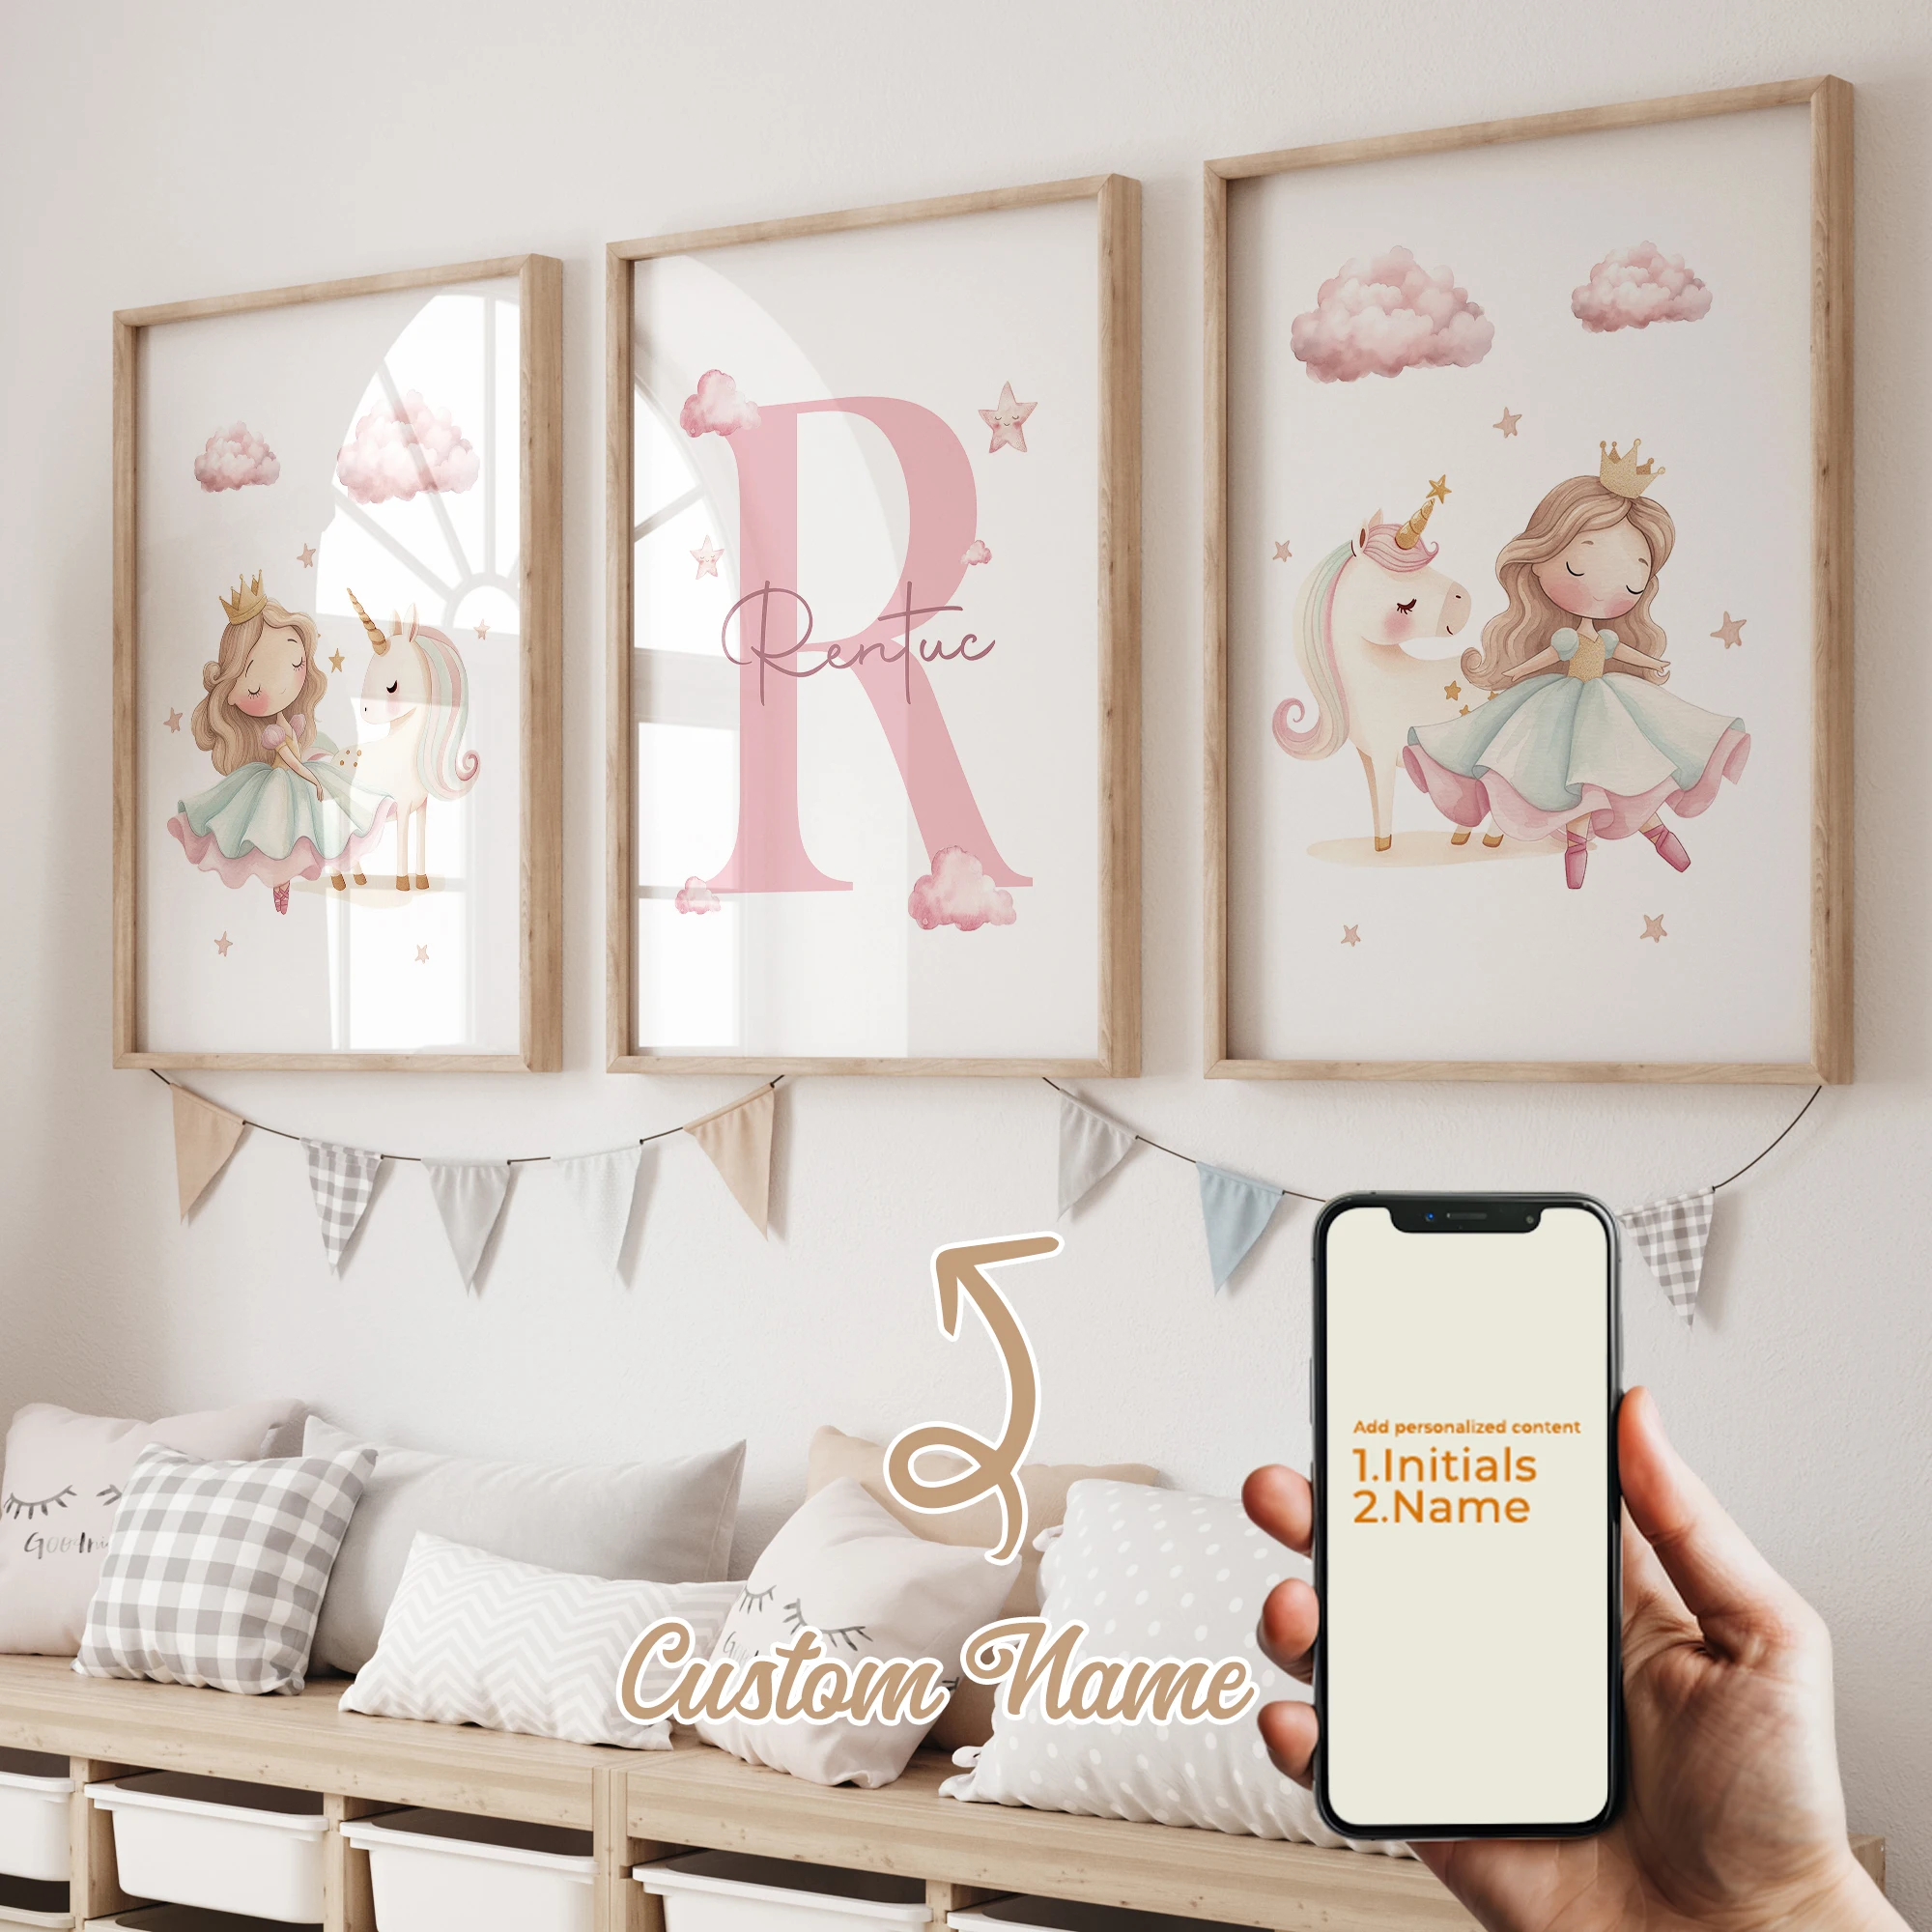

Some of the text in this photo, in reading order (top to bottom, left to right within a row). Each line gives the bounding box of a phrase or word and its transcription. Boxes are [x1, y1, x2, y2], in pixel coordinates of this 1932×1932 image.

[703, 396, 1034, 894] R
[721, 580, 997, 706] Rentuc
[1352, 1419, 1582, 1437] Add personalized content
[1352, 1489, 1531, 1523] 2.Name
